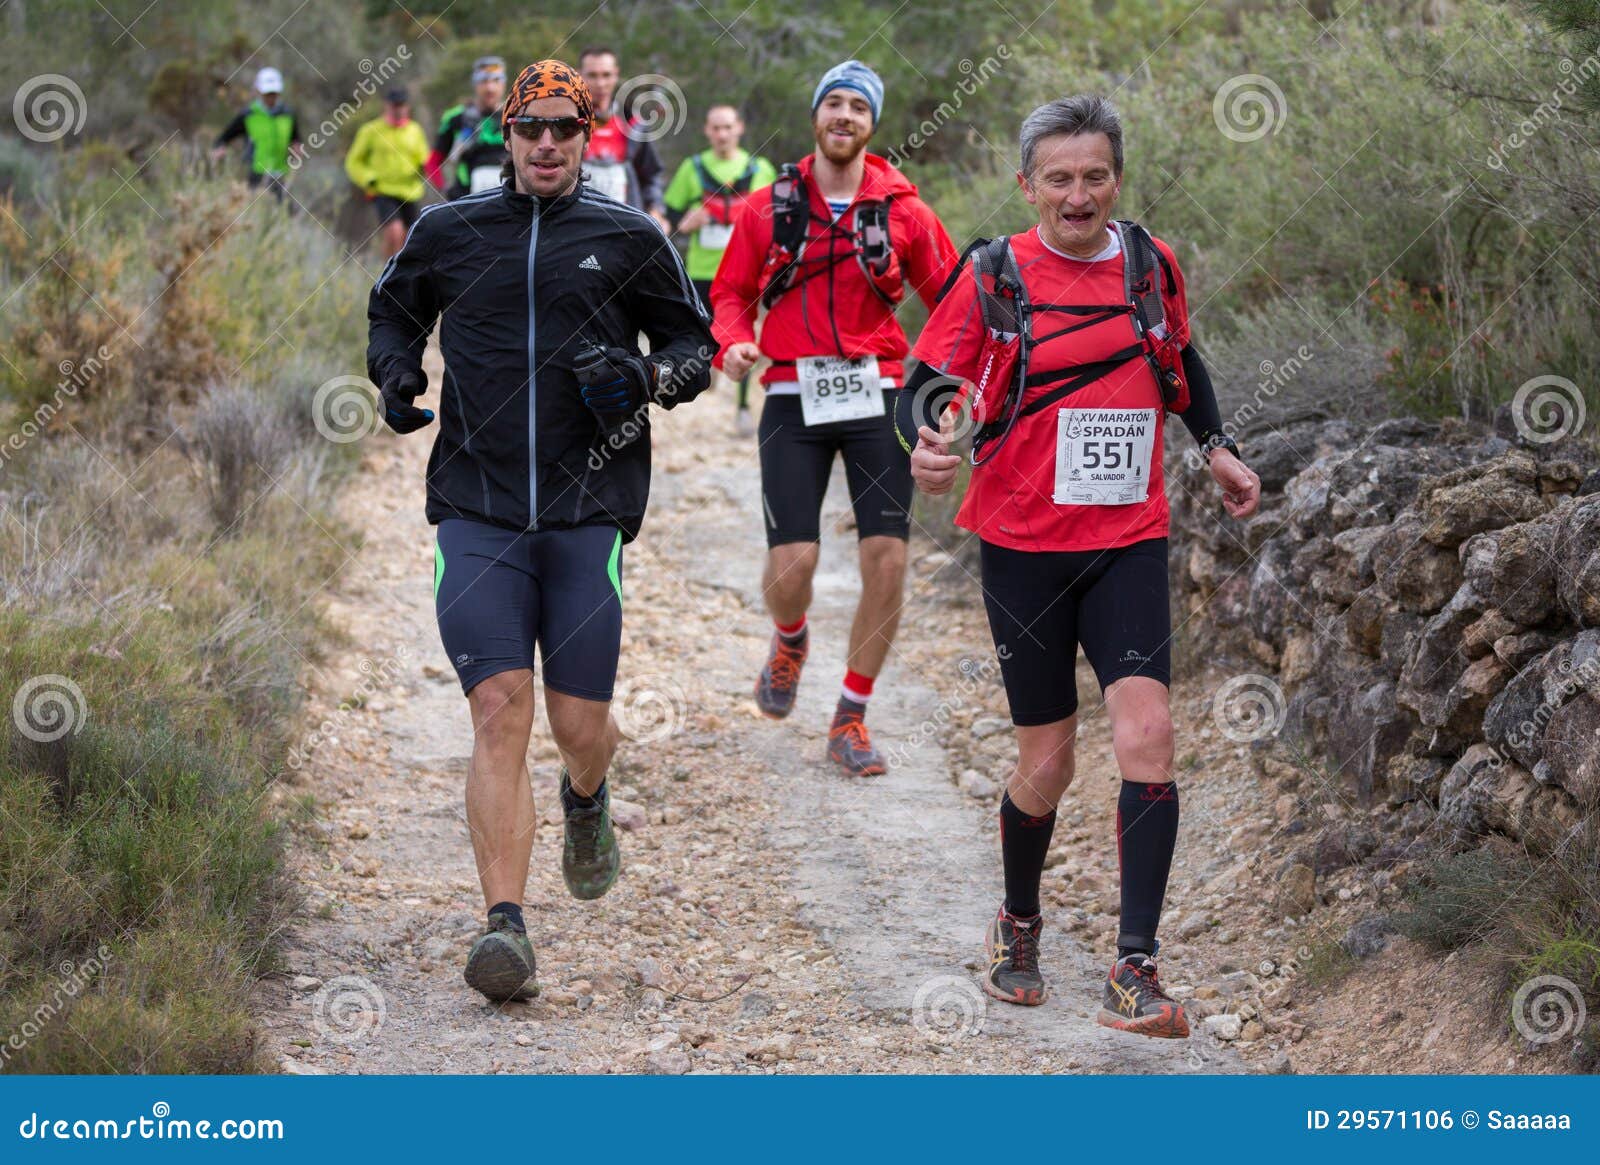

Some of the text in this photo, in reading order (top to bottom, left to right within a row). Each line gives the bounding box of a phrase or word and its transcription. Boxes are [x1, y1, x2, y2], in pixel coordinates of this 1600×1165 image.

[578, 263, 602, 271] adidas
[816, 373, 863, 398] 895
[1080, 411, 1150, 423] XV MARATÓN
[1083, 424, 1145, 437] SPADÁN
[1082, 441, 1134, 469] 551
[1090, 473, 1126, 481] SALVADOR
